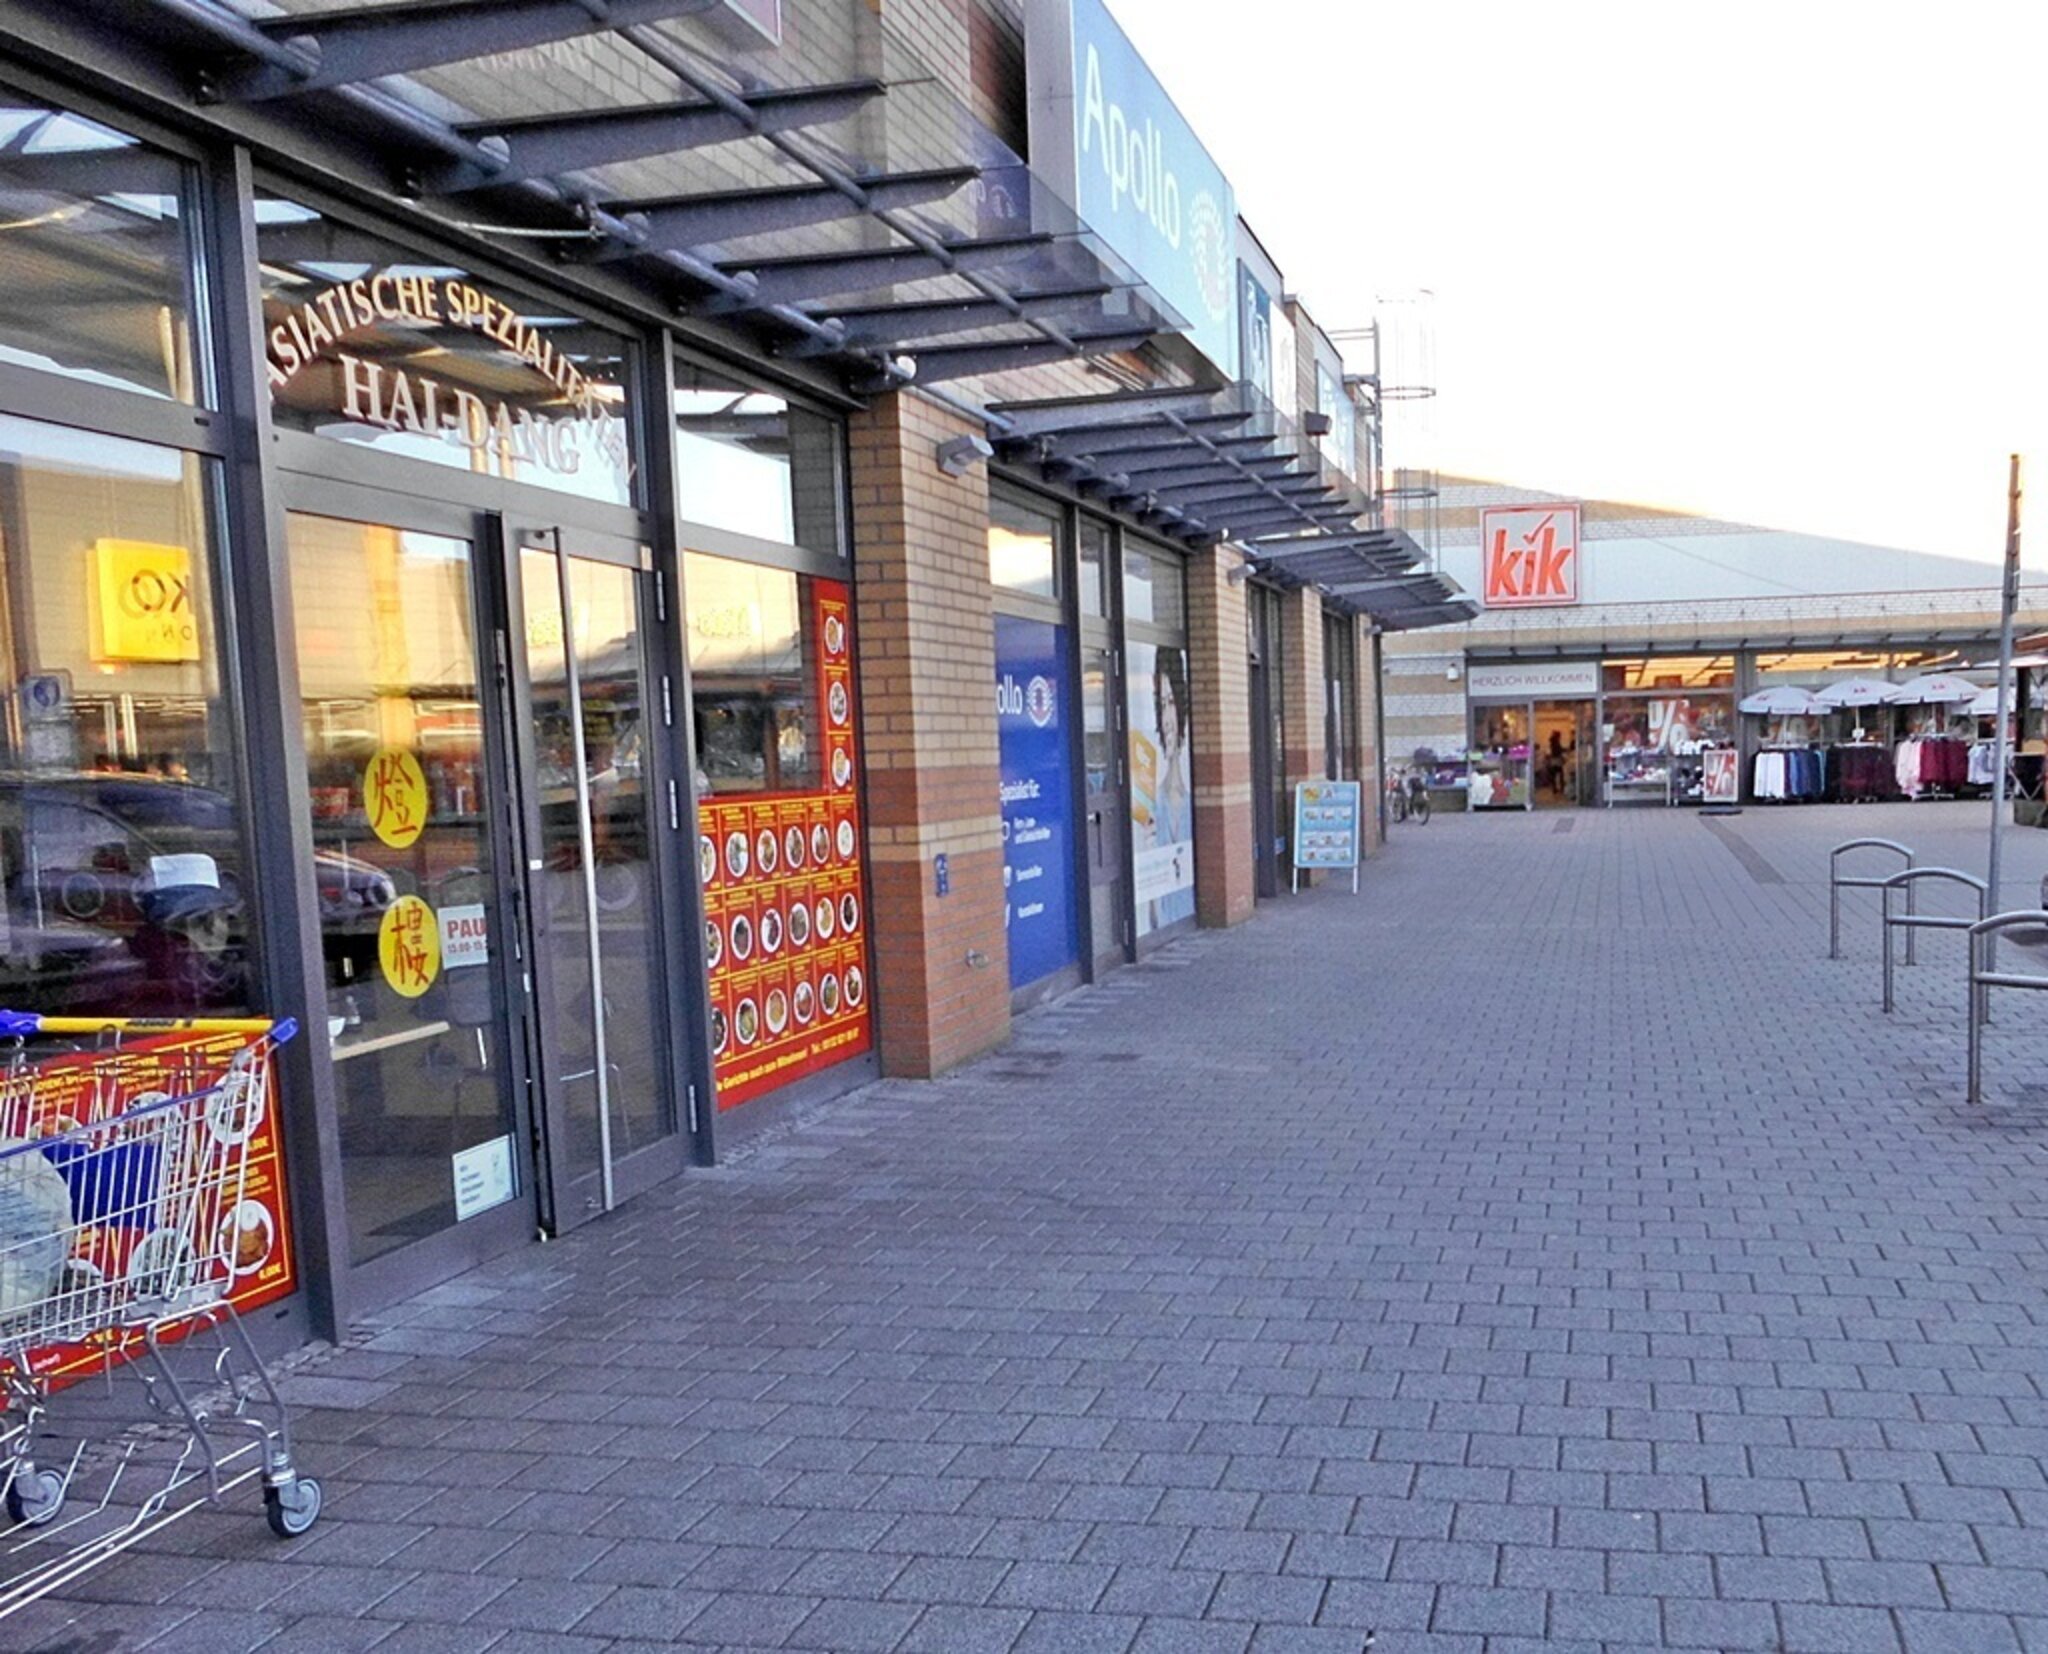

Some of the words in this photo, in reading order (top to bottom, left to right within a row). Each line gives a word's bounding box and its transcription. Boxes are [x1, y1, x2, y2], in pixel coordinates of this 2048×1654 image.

[1083, 42, 1180, 250] Apollo
[338, 353, 582, 475] HAI-DANG
[1471, 675, 1522, 688] HERZLICH
[1525, 672, 1593, 686] WILLKOMMEN
